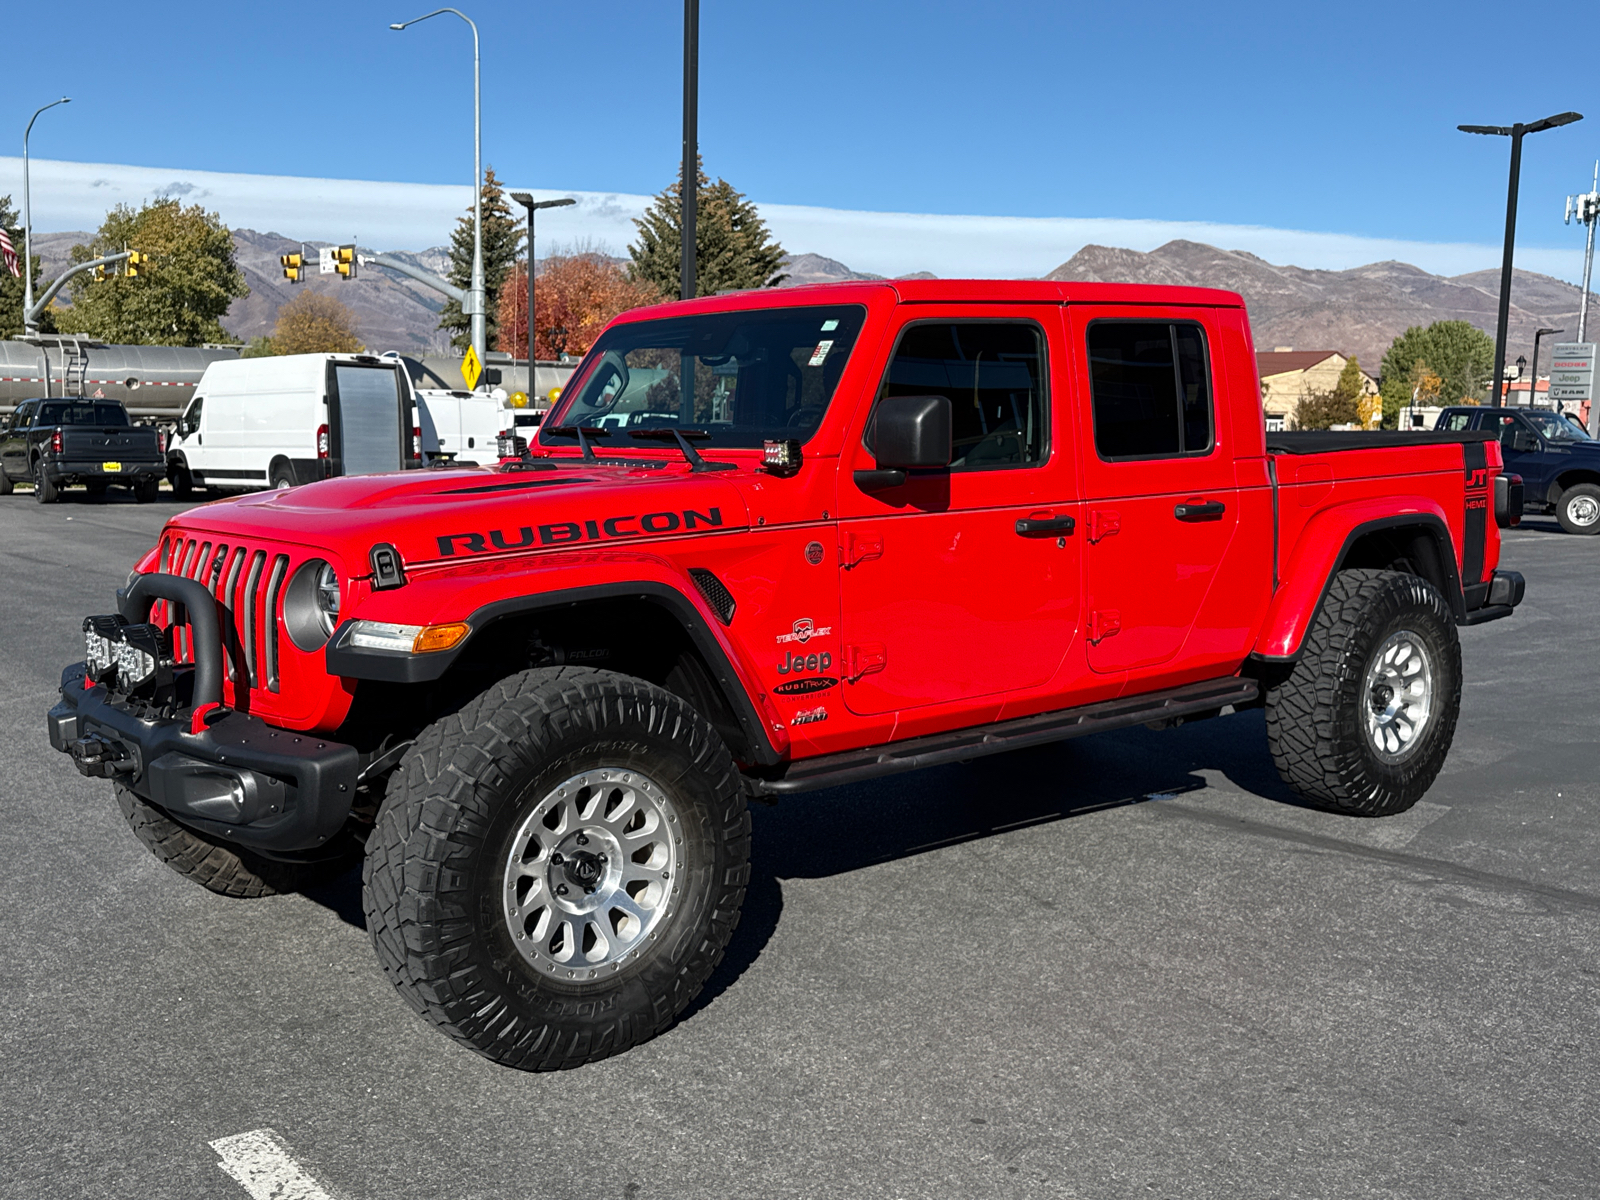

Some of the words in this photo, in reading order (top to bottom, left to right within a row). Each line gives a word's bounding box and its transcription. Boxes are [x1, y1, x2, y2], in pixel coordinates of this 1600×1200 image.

[1558, 373, 1581, 383] Jeep
[1466, 468, 1487, 486] JT
[1465, 499, 1487, 510] HEMI
[436, 507, 723, 556] RUBICON
[776, 626, 832, 644] TERAFLEX
[568, 648, 611, 660] FALCON
[777, 650, 832, 675] Jeep
[781, 691, 831, 703] CONVERSIONS
